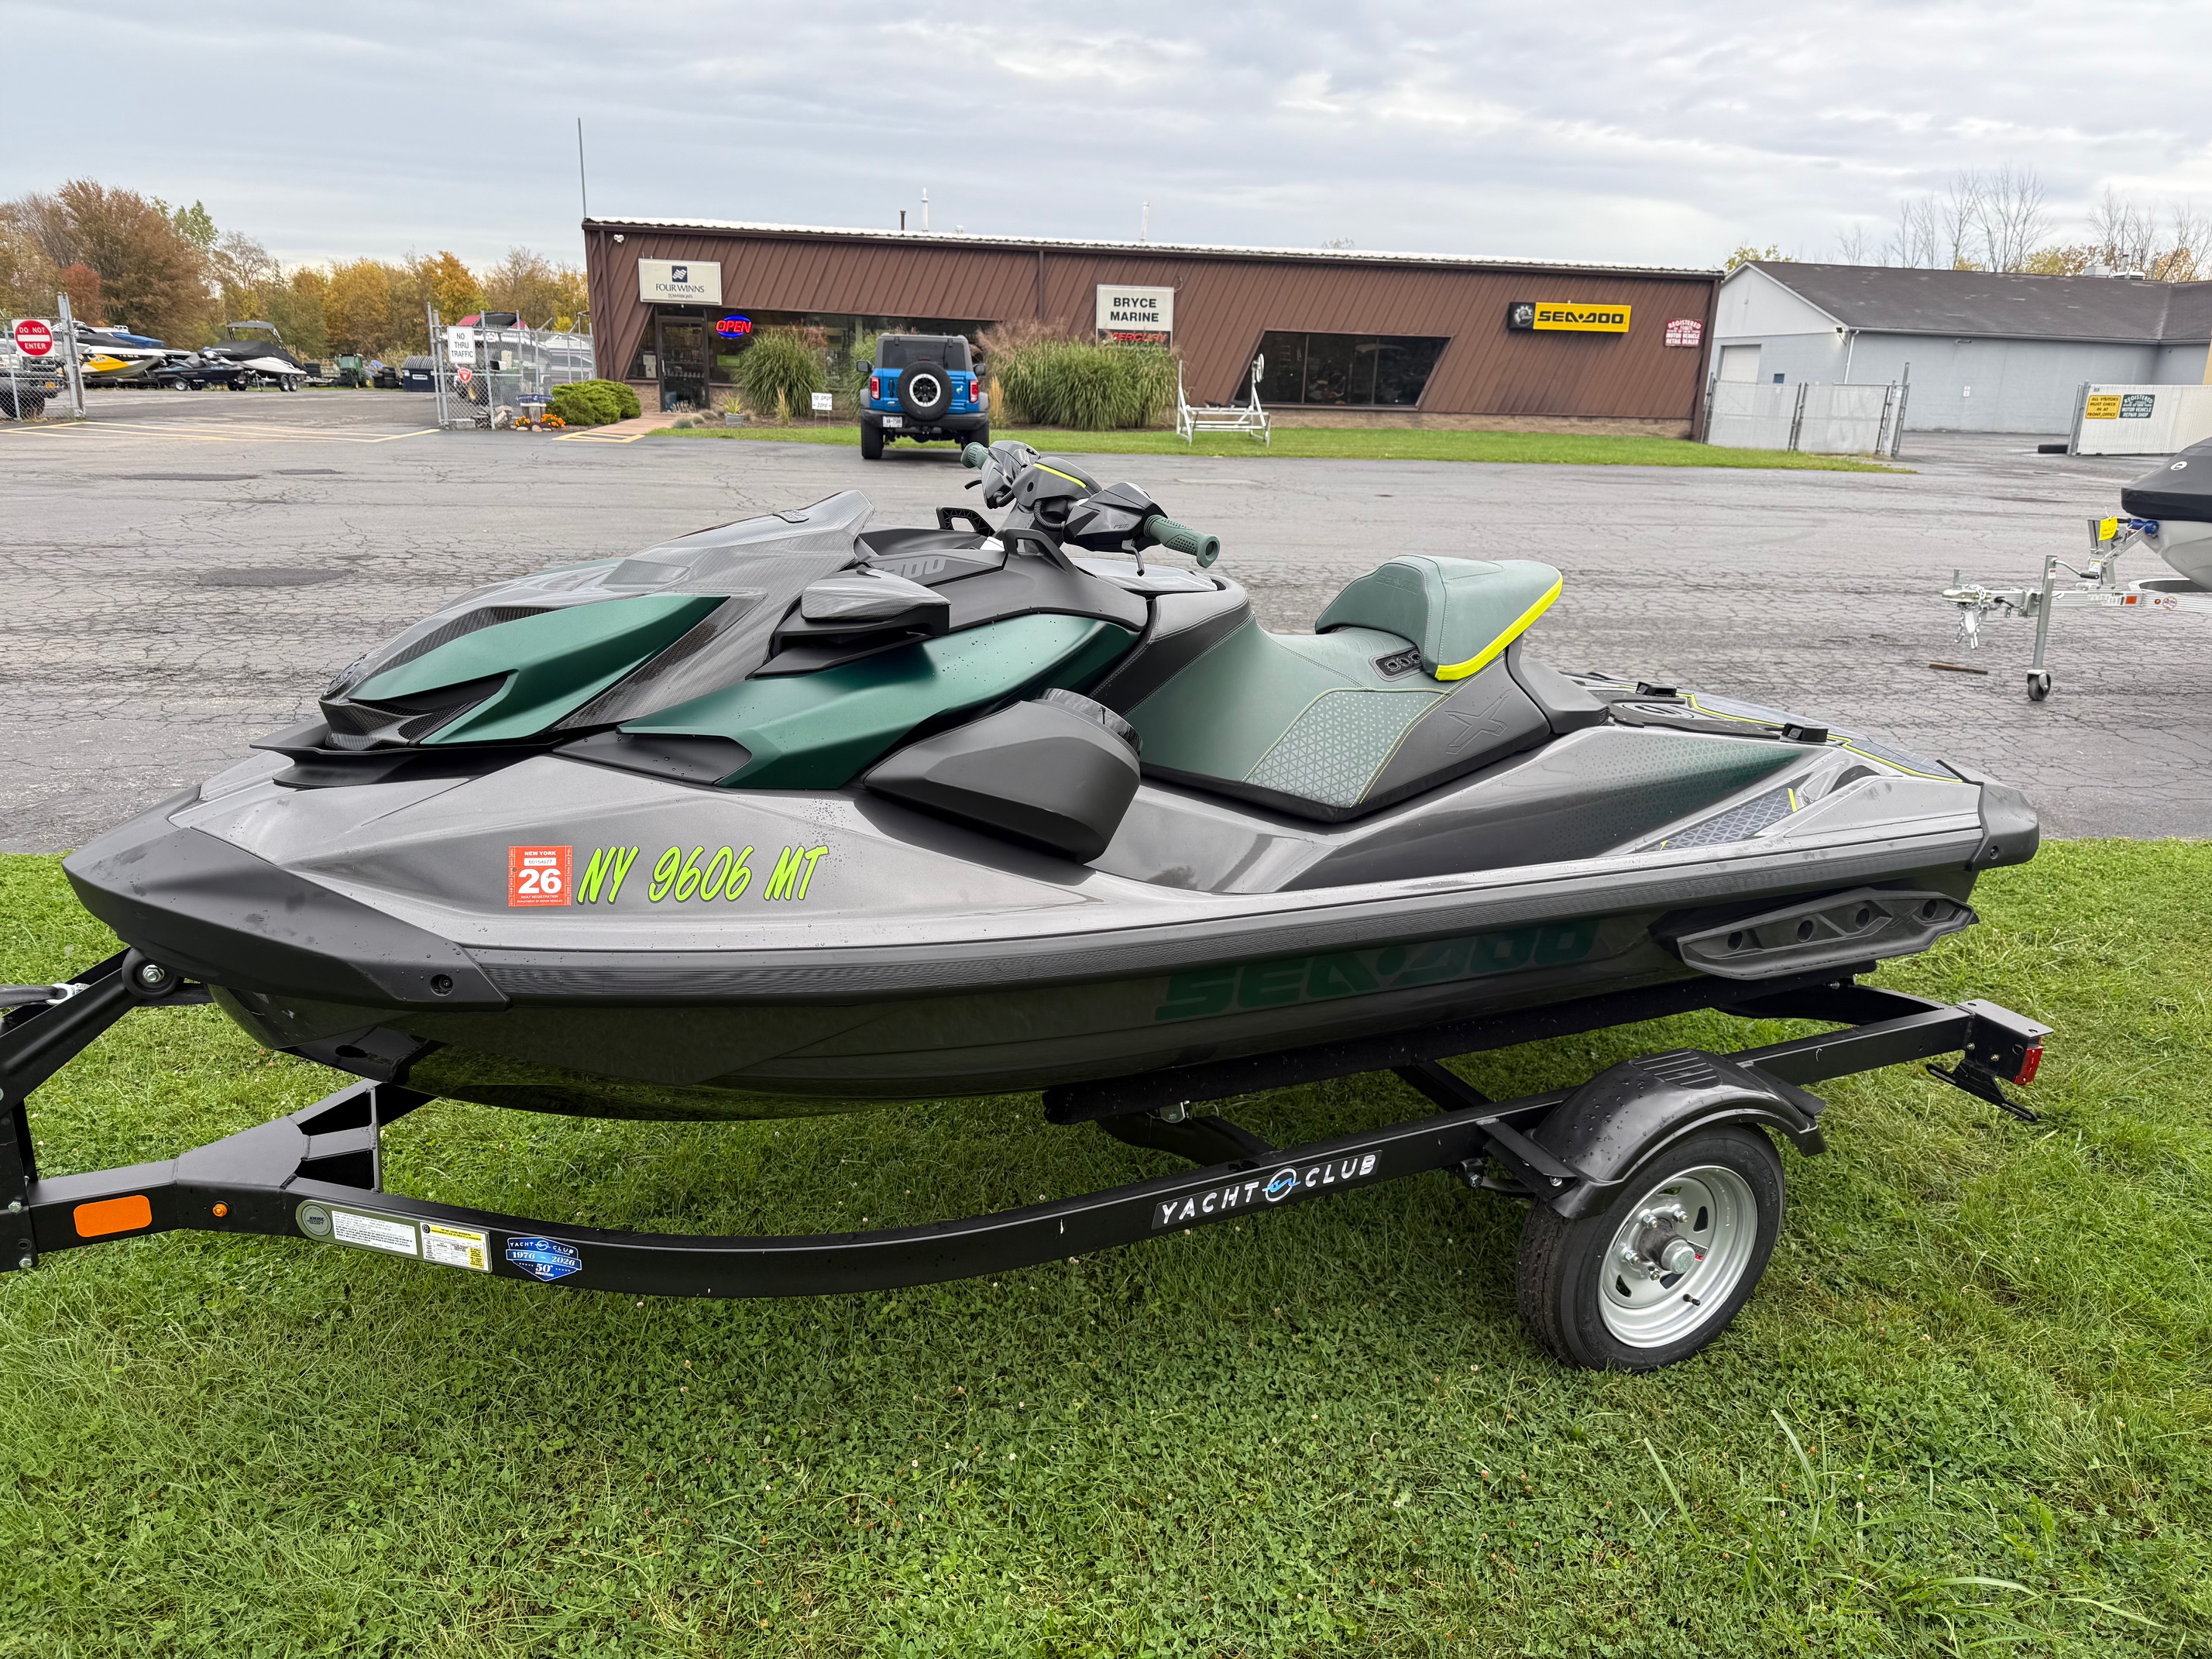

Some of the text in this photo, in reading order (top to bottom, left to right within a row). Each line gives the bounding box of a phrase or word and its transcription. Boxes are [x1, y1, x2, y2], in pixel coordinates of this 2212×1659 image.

[655, 283, 677, 292] FOUR
[1113, 297, 1157, 308] BRYCE
[1110, 311, 1159, 322] MARINE
[716, 320, 752, 333] OPEN
[1668, 319, 1702, 329] REGISTERED
[2124, 394, 2153, 404] REGISTERED
[576, 845, 830, 905] NY 9606 MT
[517, 868, 562, 894] 26
[1162, 1155, 1376, 1224] YACHT CLUB
[552, 1245, 574, 1254] CLUB
[551, 1255, 575, 1266] 2026
